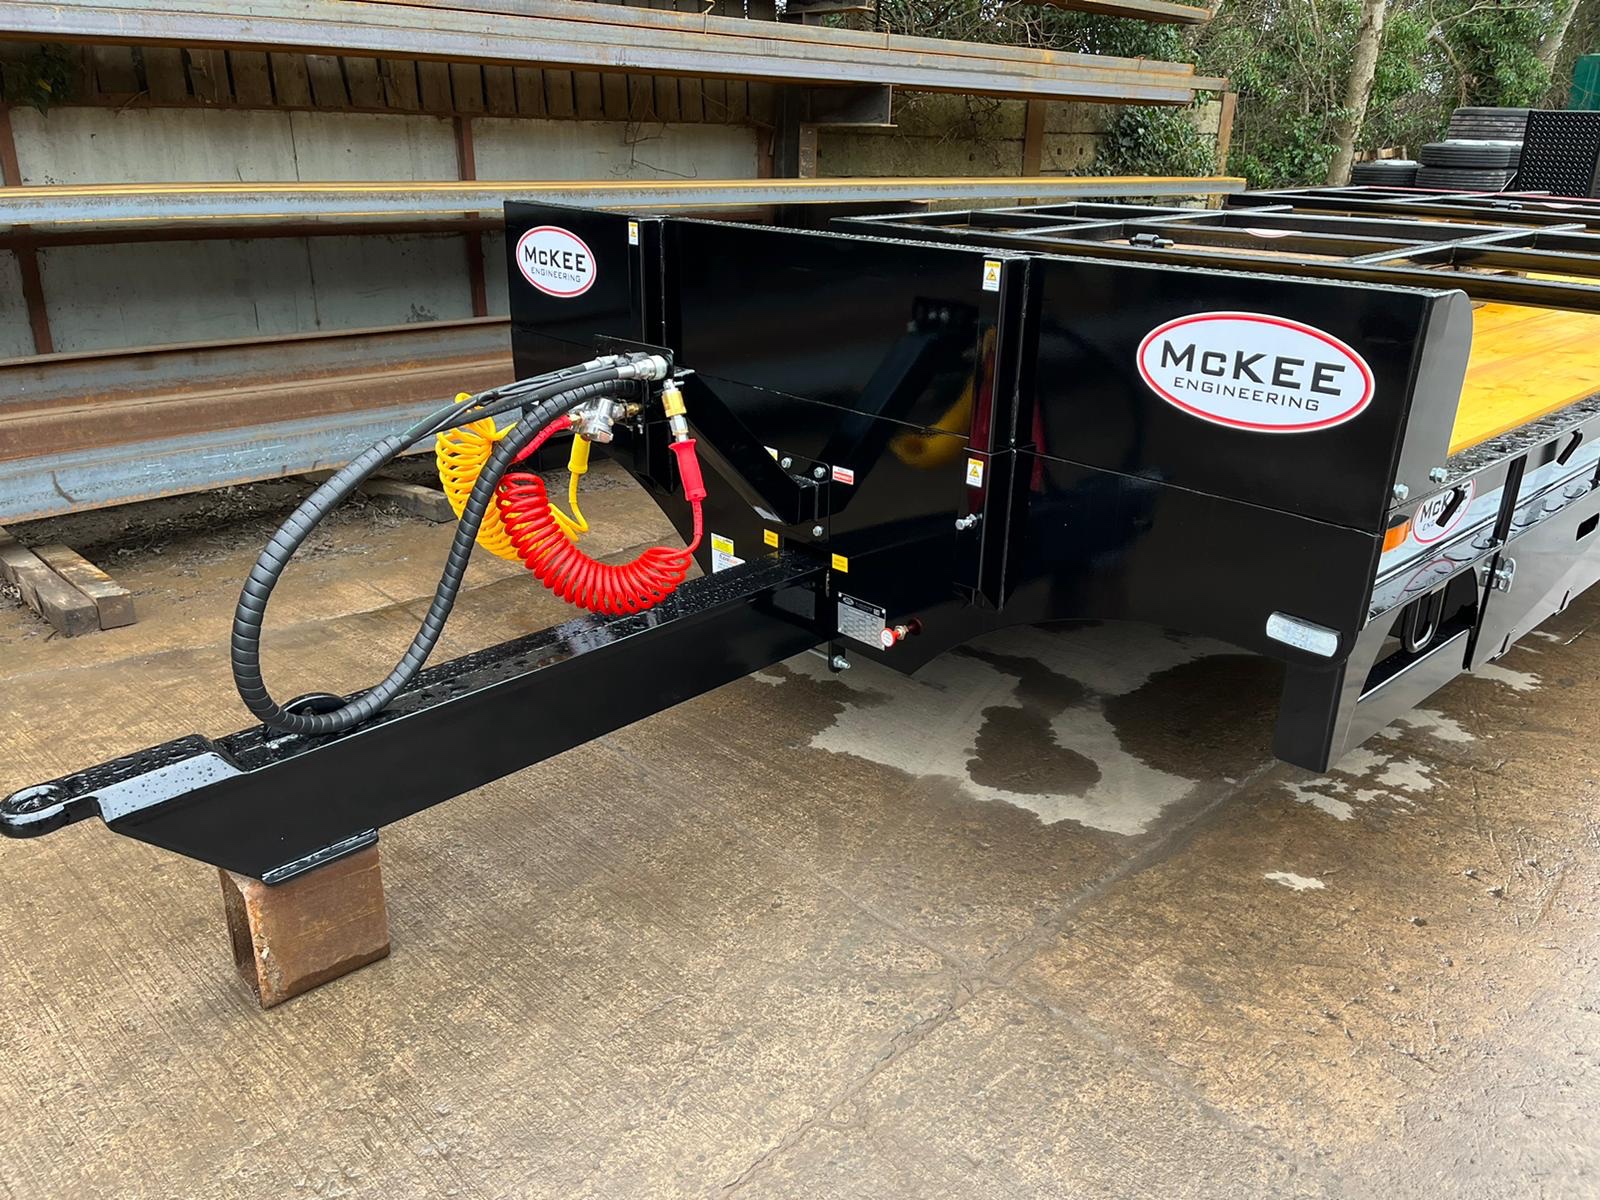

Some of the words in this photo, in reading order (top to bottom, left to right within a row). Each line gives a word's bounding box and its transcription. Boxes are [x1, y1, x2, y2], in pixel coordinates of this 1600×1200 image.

[524, 245, 586, 273] McKEE
[531, 267, 581, 283] ENGINEERING
[1160, 339, 1346, 397] McKEE
[1173, 376, 1321, 412] ENGINEERING
